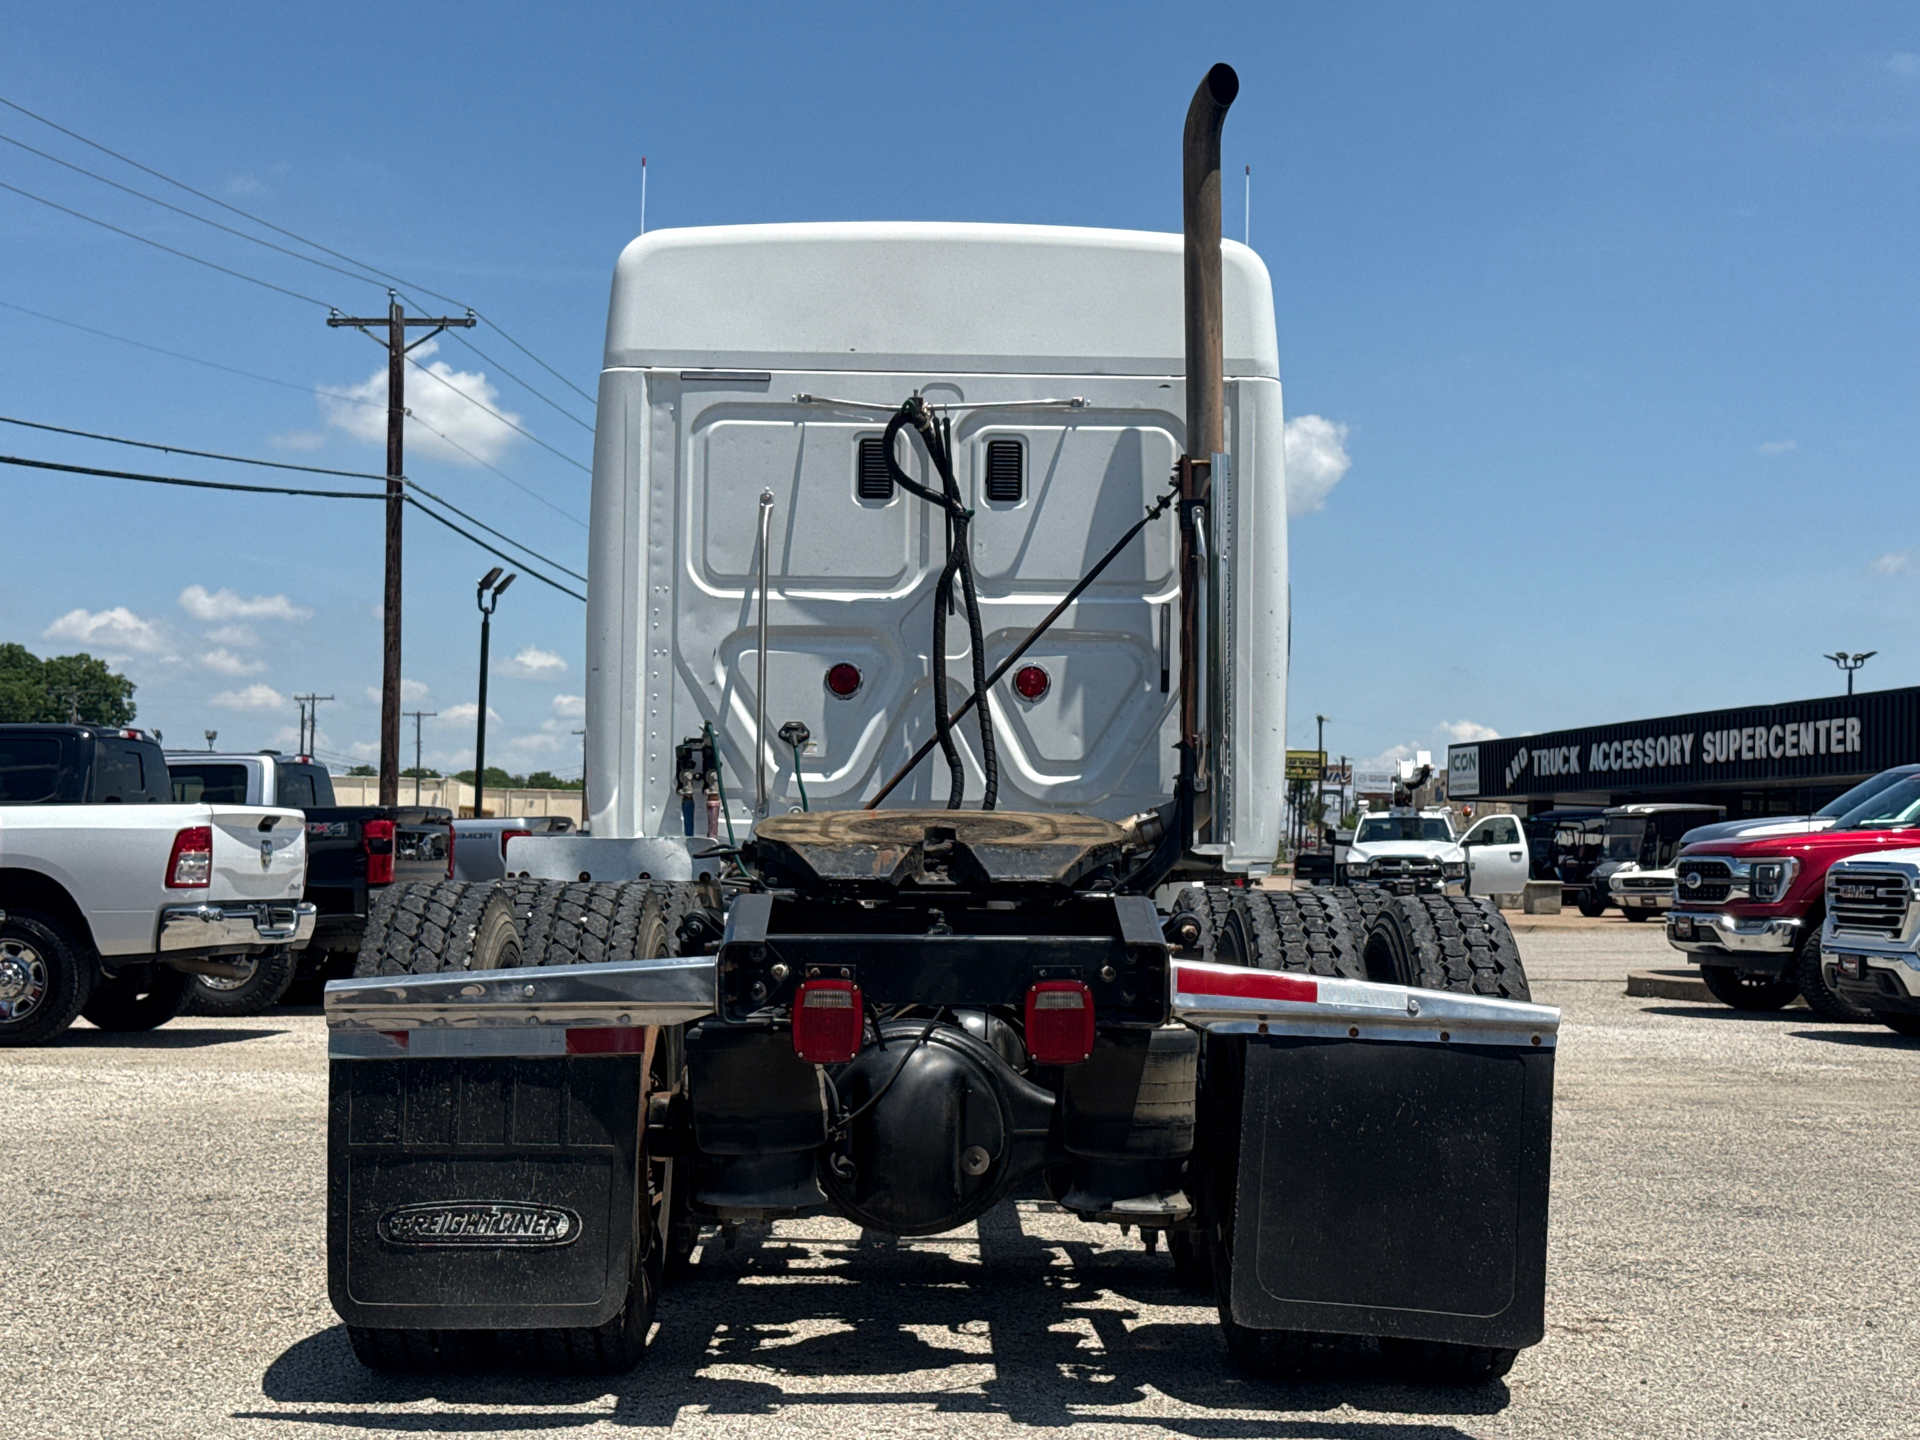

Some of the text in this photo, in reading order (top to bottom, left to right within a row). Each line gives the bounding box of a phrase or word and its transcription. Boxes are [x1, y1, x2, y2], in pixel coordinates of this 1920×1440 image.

[1450, 752, 1477, 773] ICON
[1505, 716, 1861, 790] AND TRUCK ACCESSORY SUPERCENTER
[1839, 884, 1876, 899] GMC
[394, 1211, 559, 1236] FREIGHTLINER
